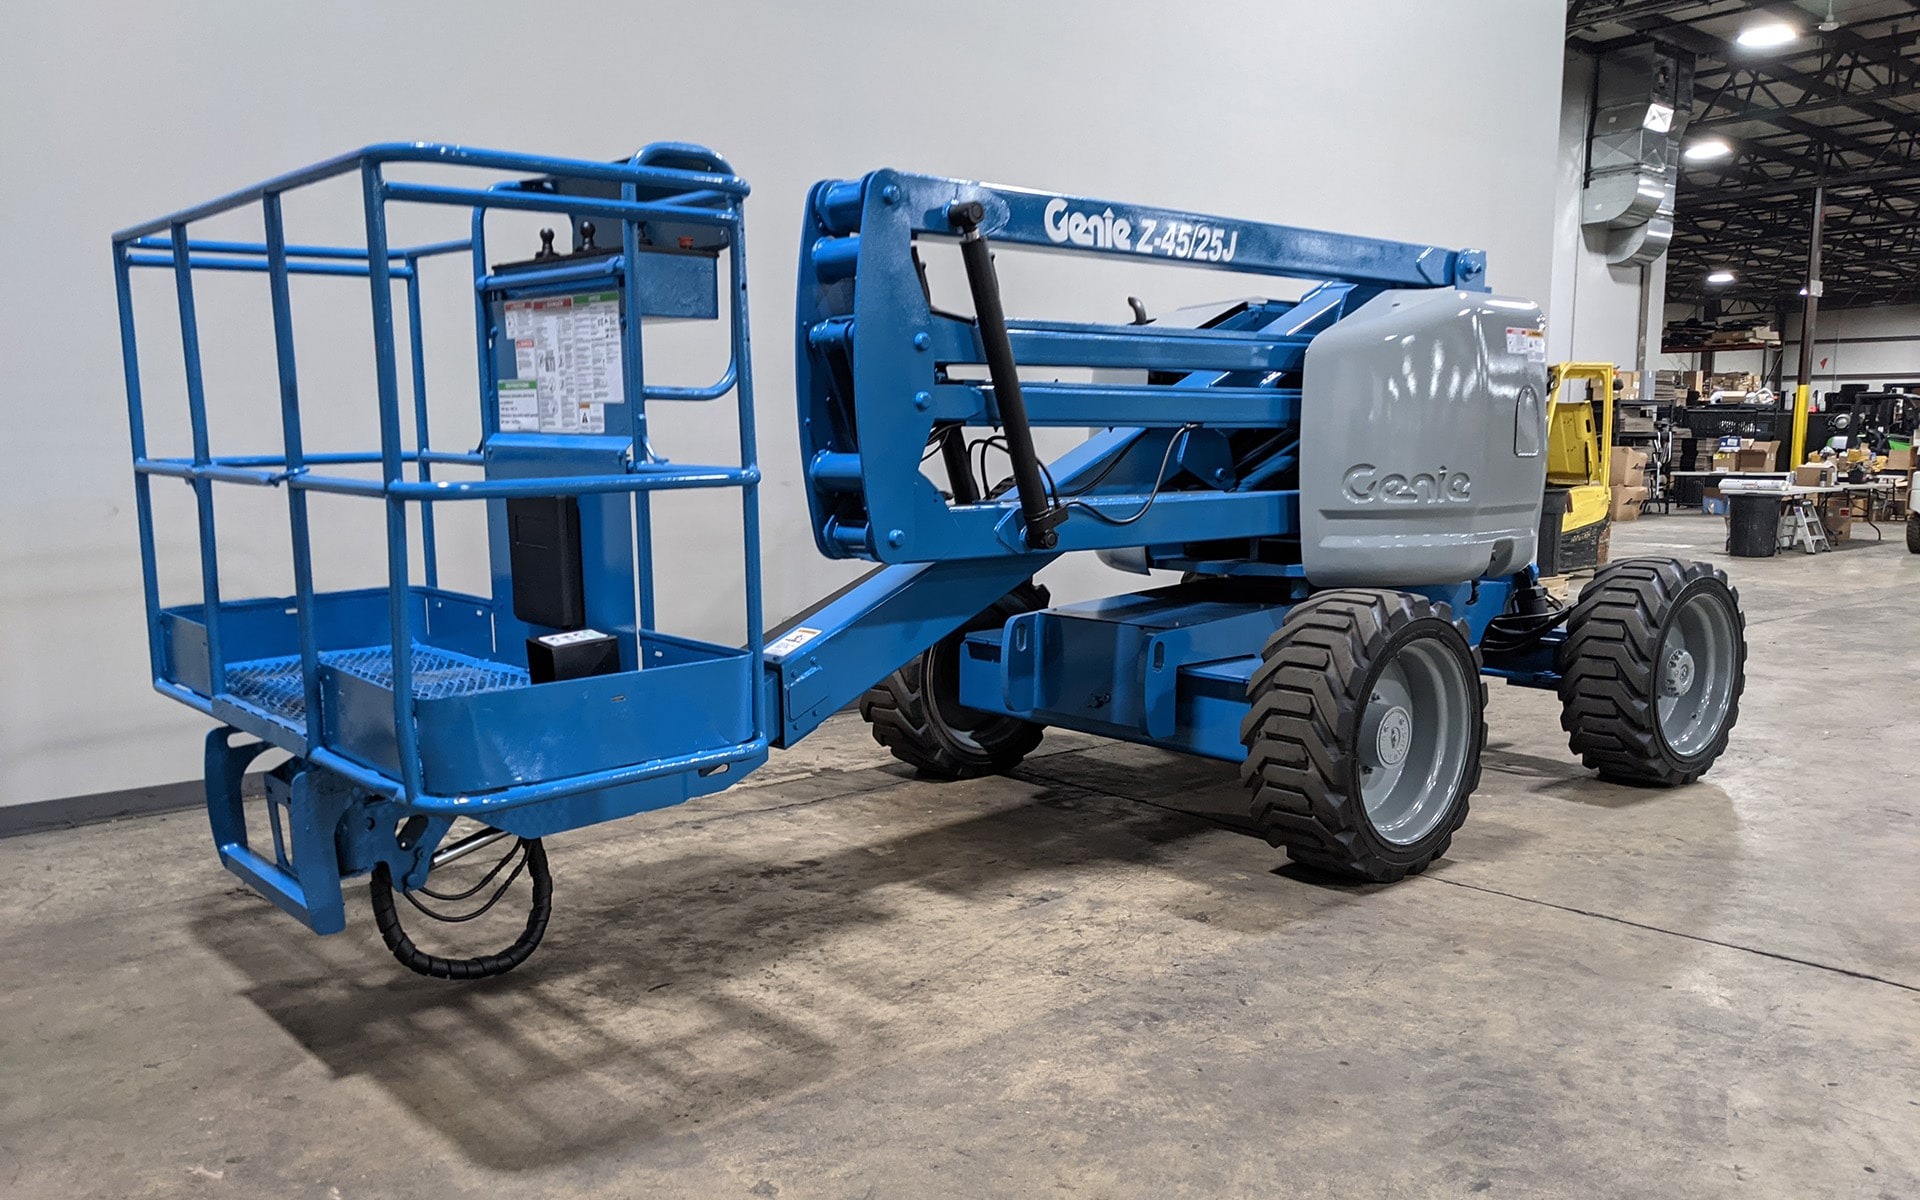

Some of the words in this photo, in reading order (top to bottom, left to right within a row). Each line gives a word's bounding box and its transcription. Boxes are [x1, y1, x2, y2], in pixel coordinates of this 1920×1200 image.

[1044, 198, 1131, 250] Genie
[1136, 219, 1238, 263] Z-45/25J
[1342, 463, 1471, 504] Genie
